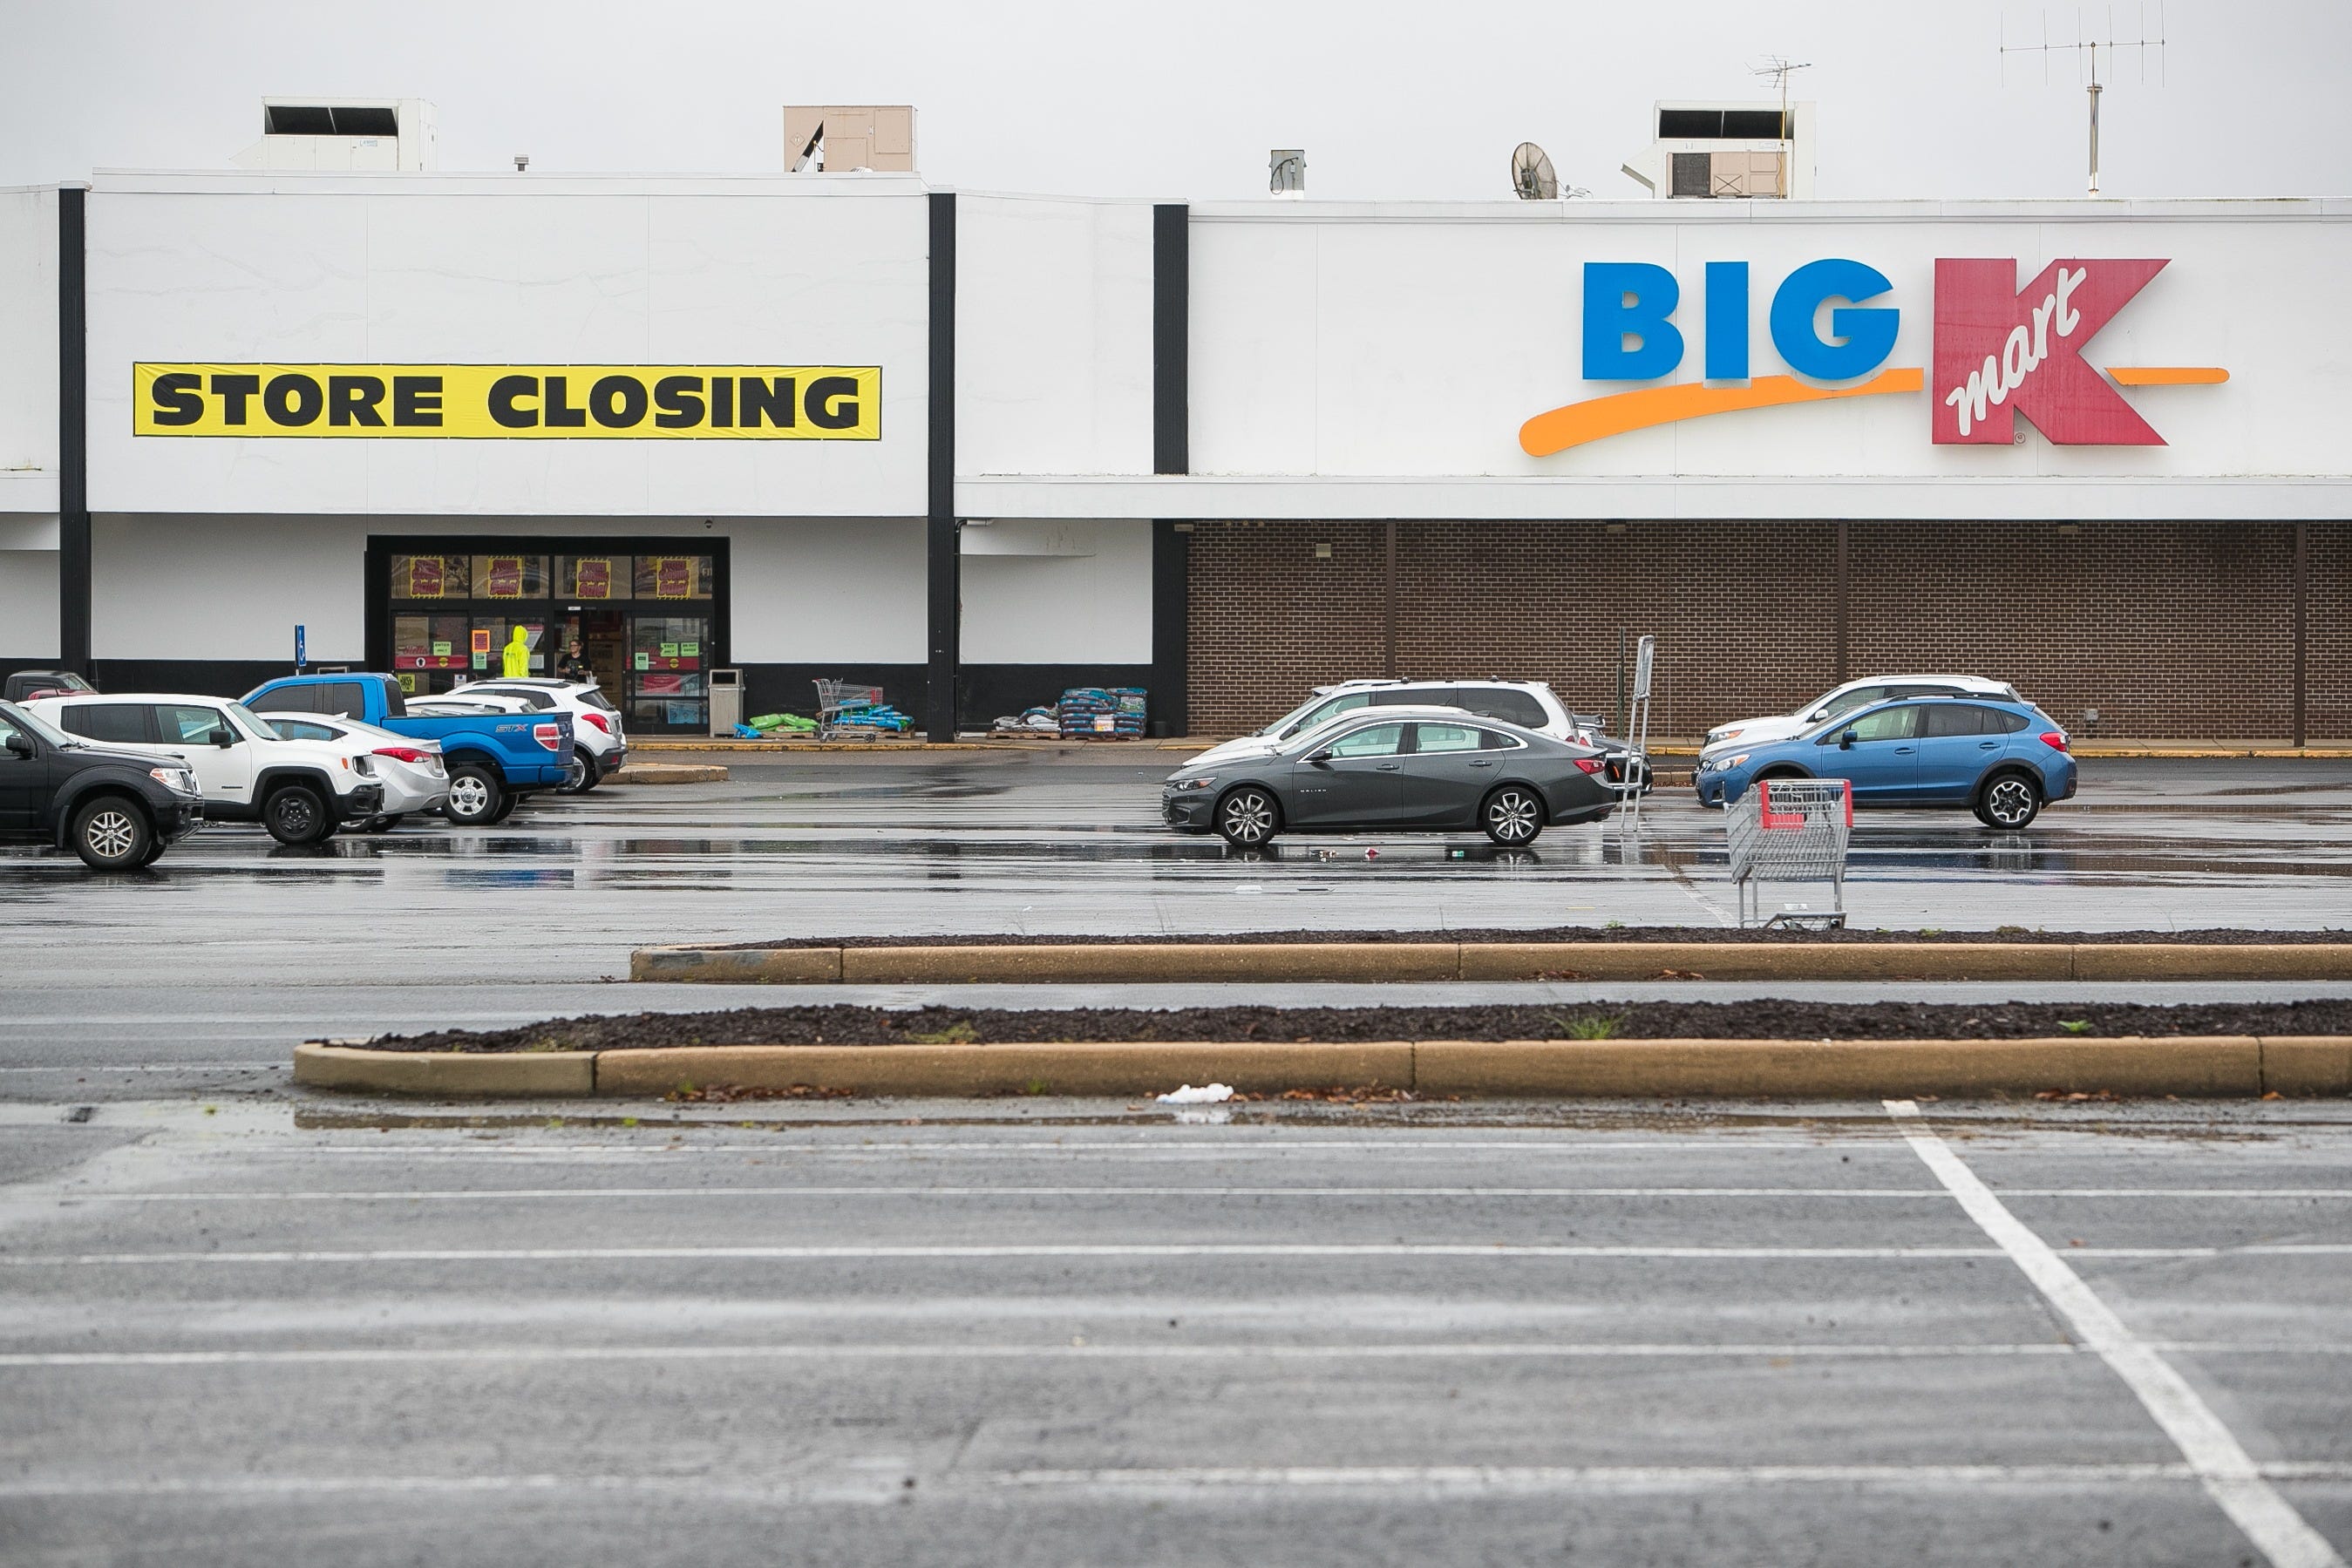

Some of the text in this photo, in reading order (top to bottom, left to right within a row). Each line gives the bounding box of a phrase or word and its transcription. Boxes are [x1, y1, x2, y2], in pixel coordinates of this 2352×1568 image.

[151, 372, 860, 430] STORE CLOSING
[1582, 258, 2172, 445] BIG K
[1946, 266, 2088, 437] mart
[495, 723, 528, 733] STX
